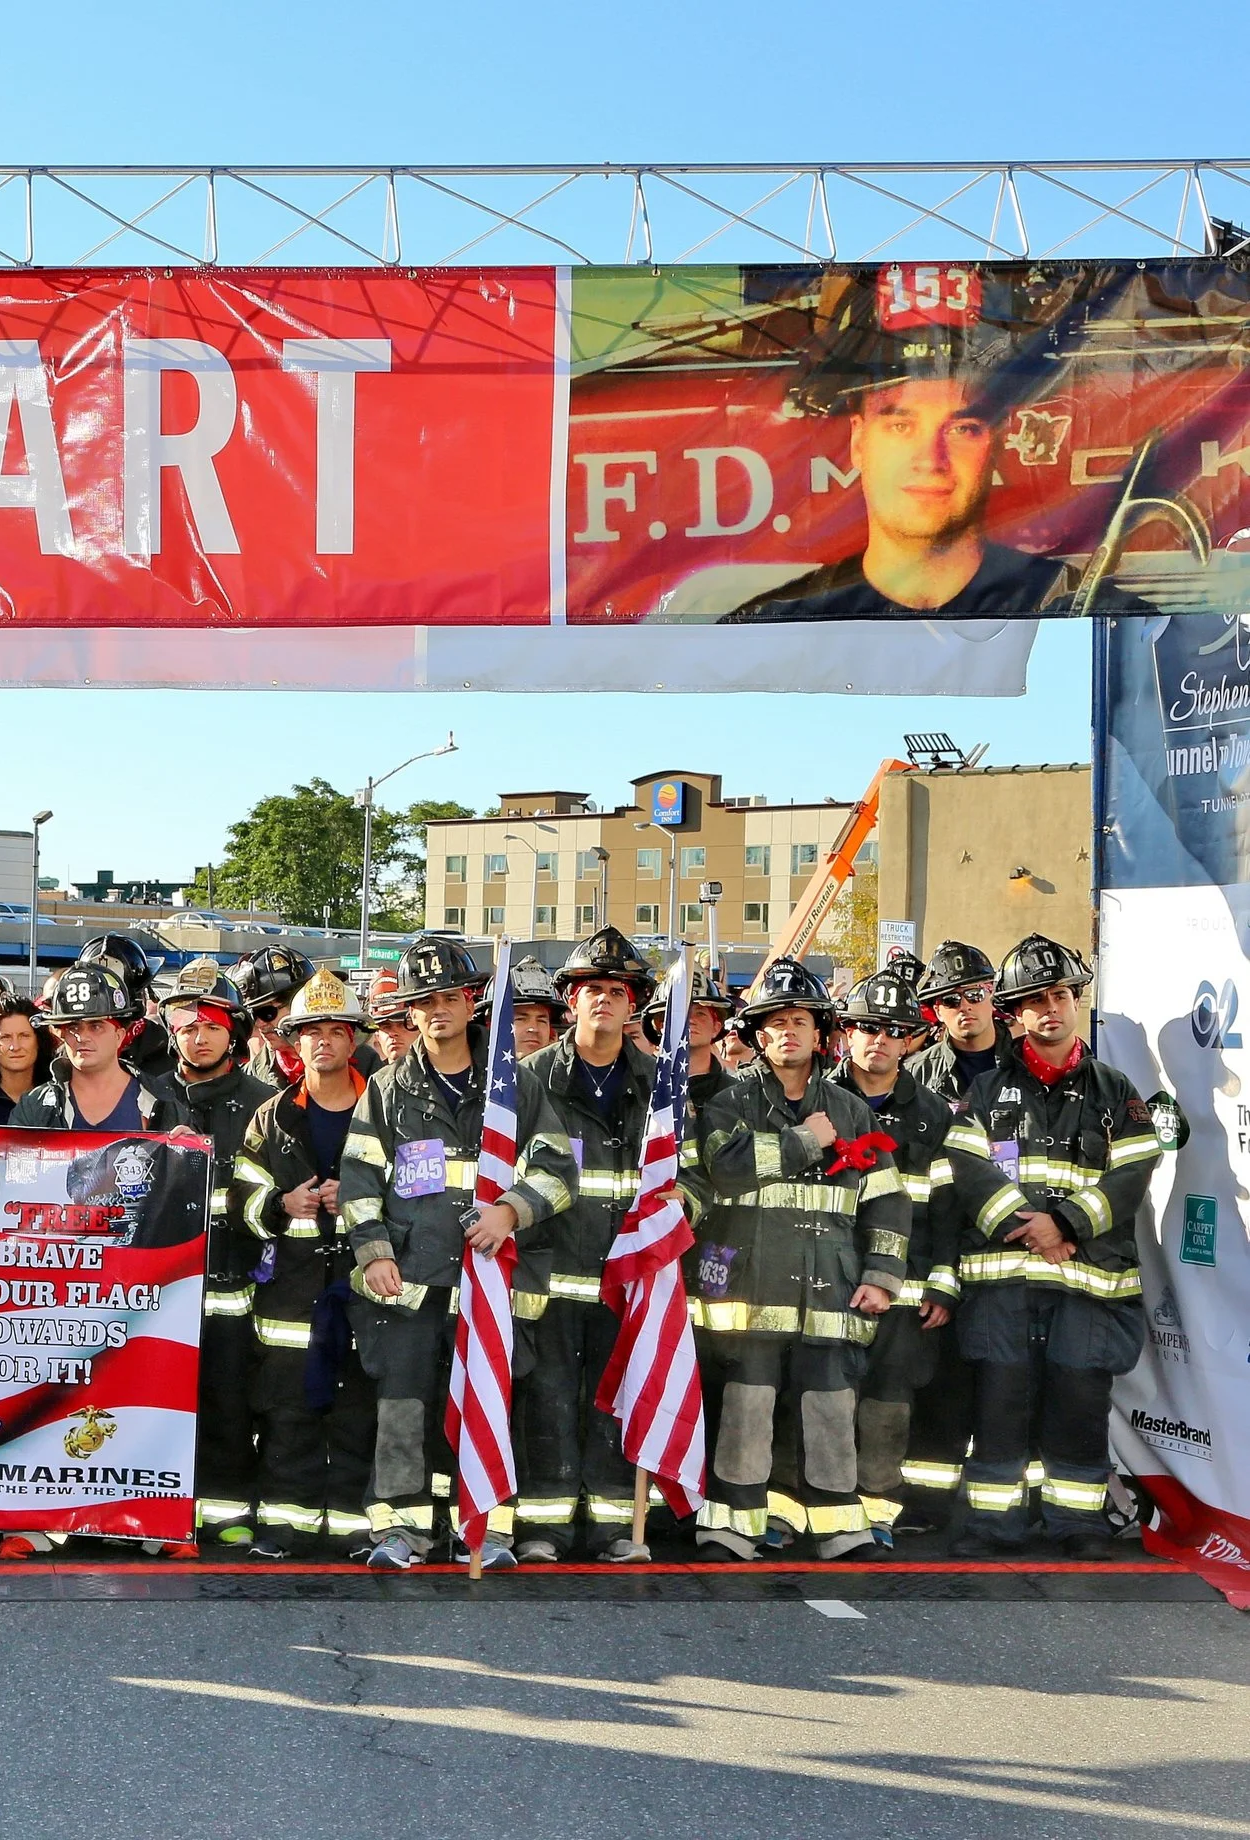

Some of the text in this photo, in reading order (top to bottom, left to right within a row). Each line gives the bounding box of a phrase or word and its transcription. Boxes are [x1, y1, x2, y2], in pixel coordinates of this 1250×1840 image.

[886, 266, 970, 314] 153
[574, 447, 792, 544] F.D.
[1165, 737, 1218, 776] unnel
[653, 808, 680, 817] Comfort
[790, 881, 836, 956] United Rentals
[886, 923, 909, 933] TRUCK
[880, 934, 913, 942] RESTRICTION
[368, 948, 395, 960] Richards
[1030, 950, 1056, 970] 10
[416, 955, 443, 978] 14
[308, 982, 341, 994] DEPUTY
[775, 972, 793, 992] 7
[66, 983, 91, 1003] 28
[874, 985, 898, 1008] 11
[124, 1164, 142, 1177] 343
[397, 1157, 443, 1187] 3645
[121, 1184, 148, 1195] POLICE
[1187, 1220, 1214, 1236] CARPET
[1192, 1234, 1207, 1247] ONE
[65, 1282, 163, 1311] FLAG!
[47, 1358, 94, 1386] IT!
[1131, 1409, 1212, 1447] MasterBrand
[35, 1486, 76, 1495] FEW.
[82, 1486, 116, 1496] THE
